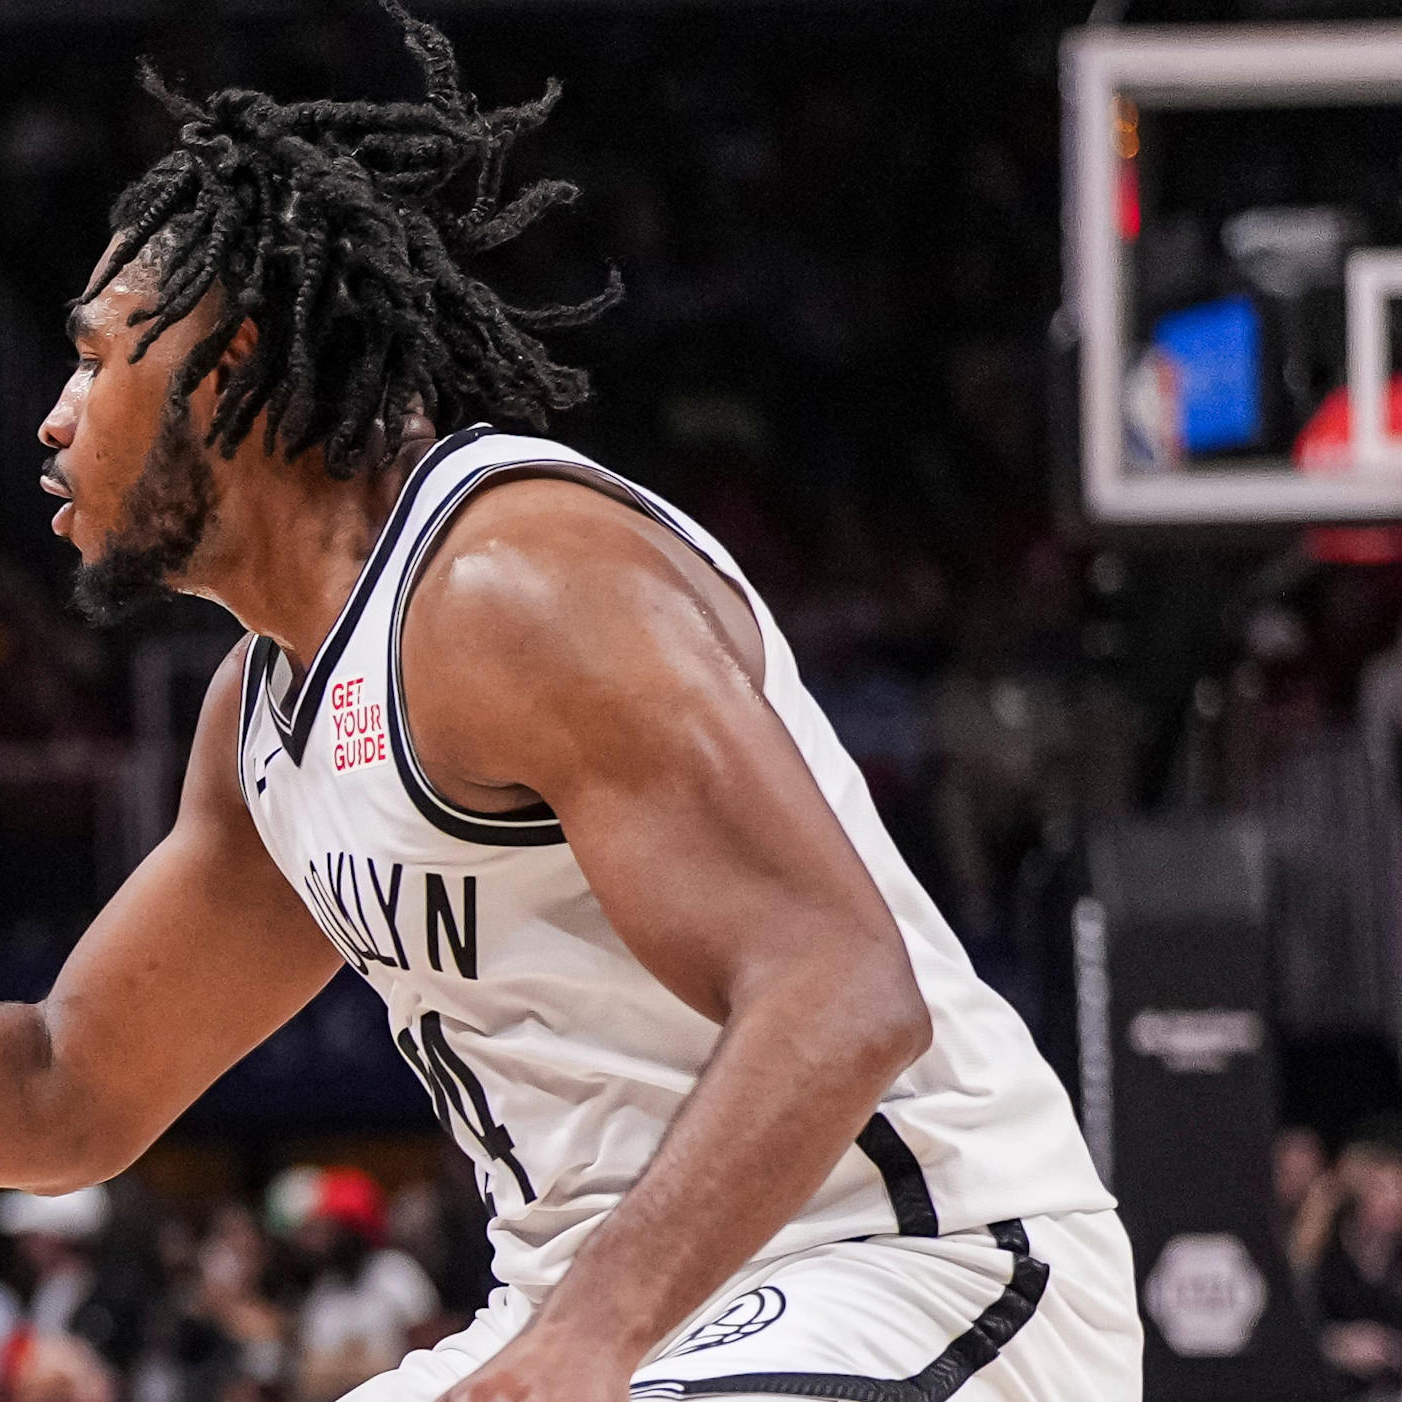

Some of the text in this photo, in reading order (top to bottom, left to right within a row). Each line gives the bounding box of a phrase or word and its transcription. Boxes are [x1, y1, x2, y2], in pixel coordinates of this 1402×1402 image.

[331, 678, 364, 711] GET
[332, 704, 382, 741] YOUR
[334, 733, 386, 772] GUIDE
